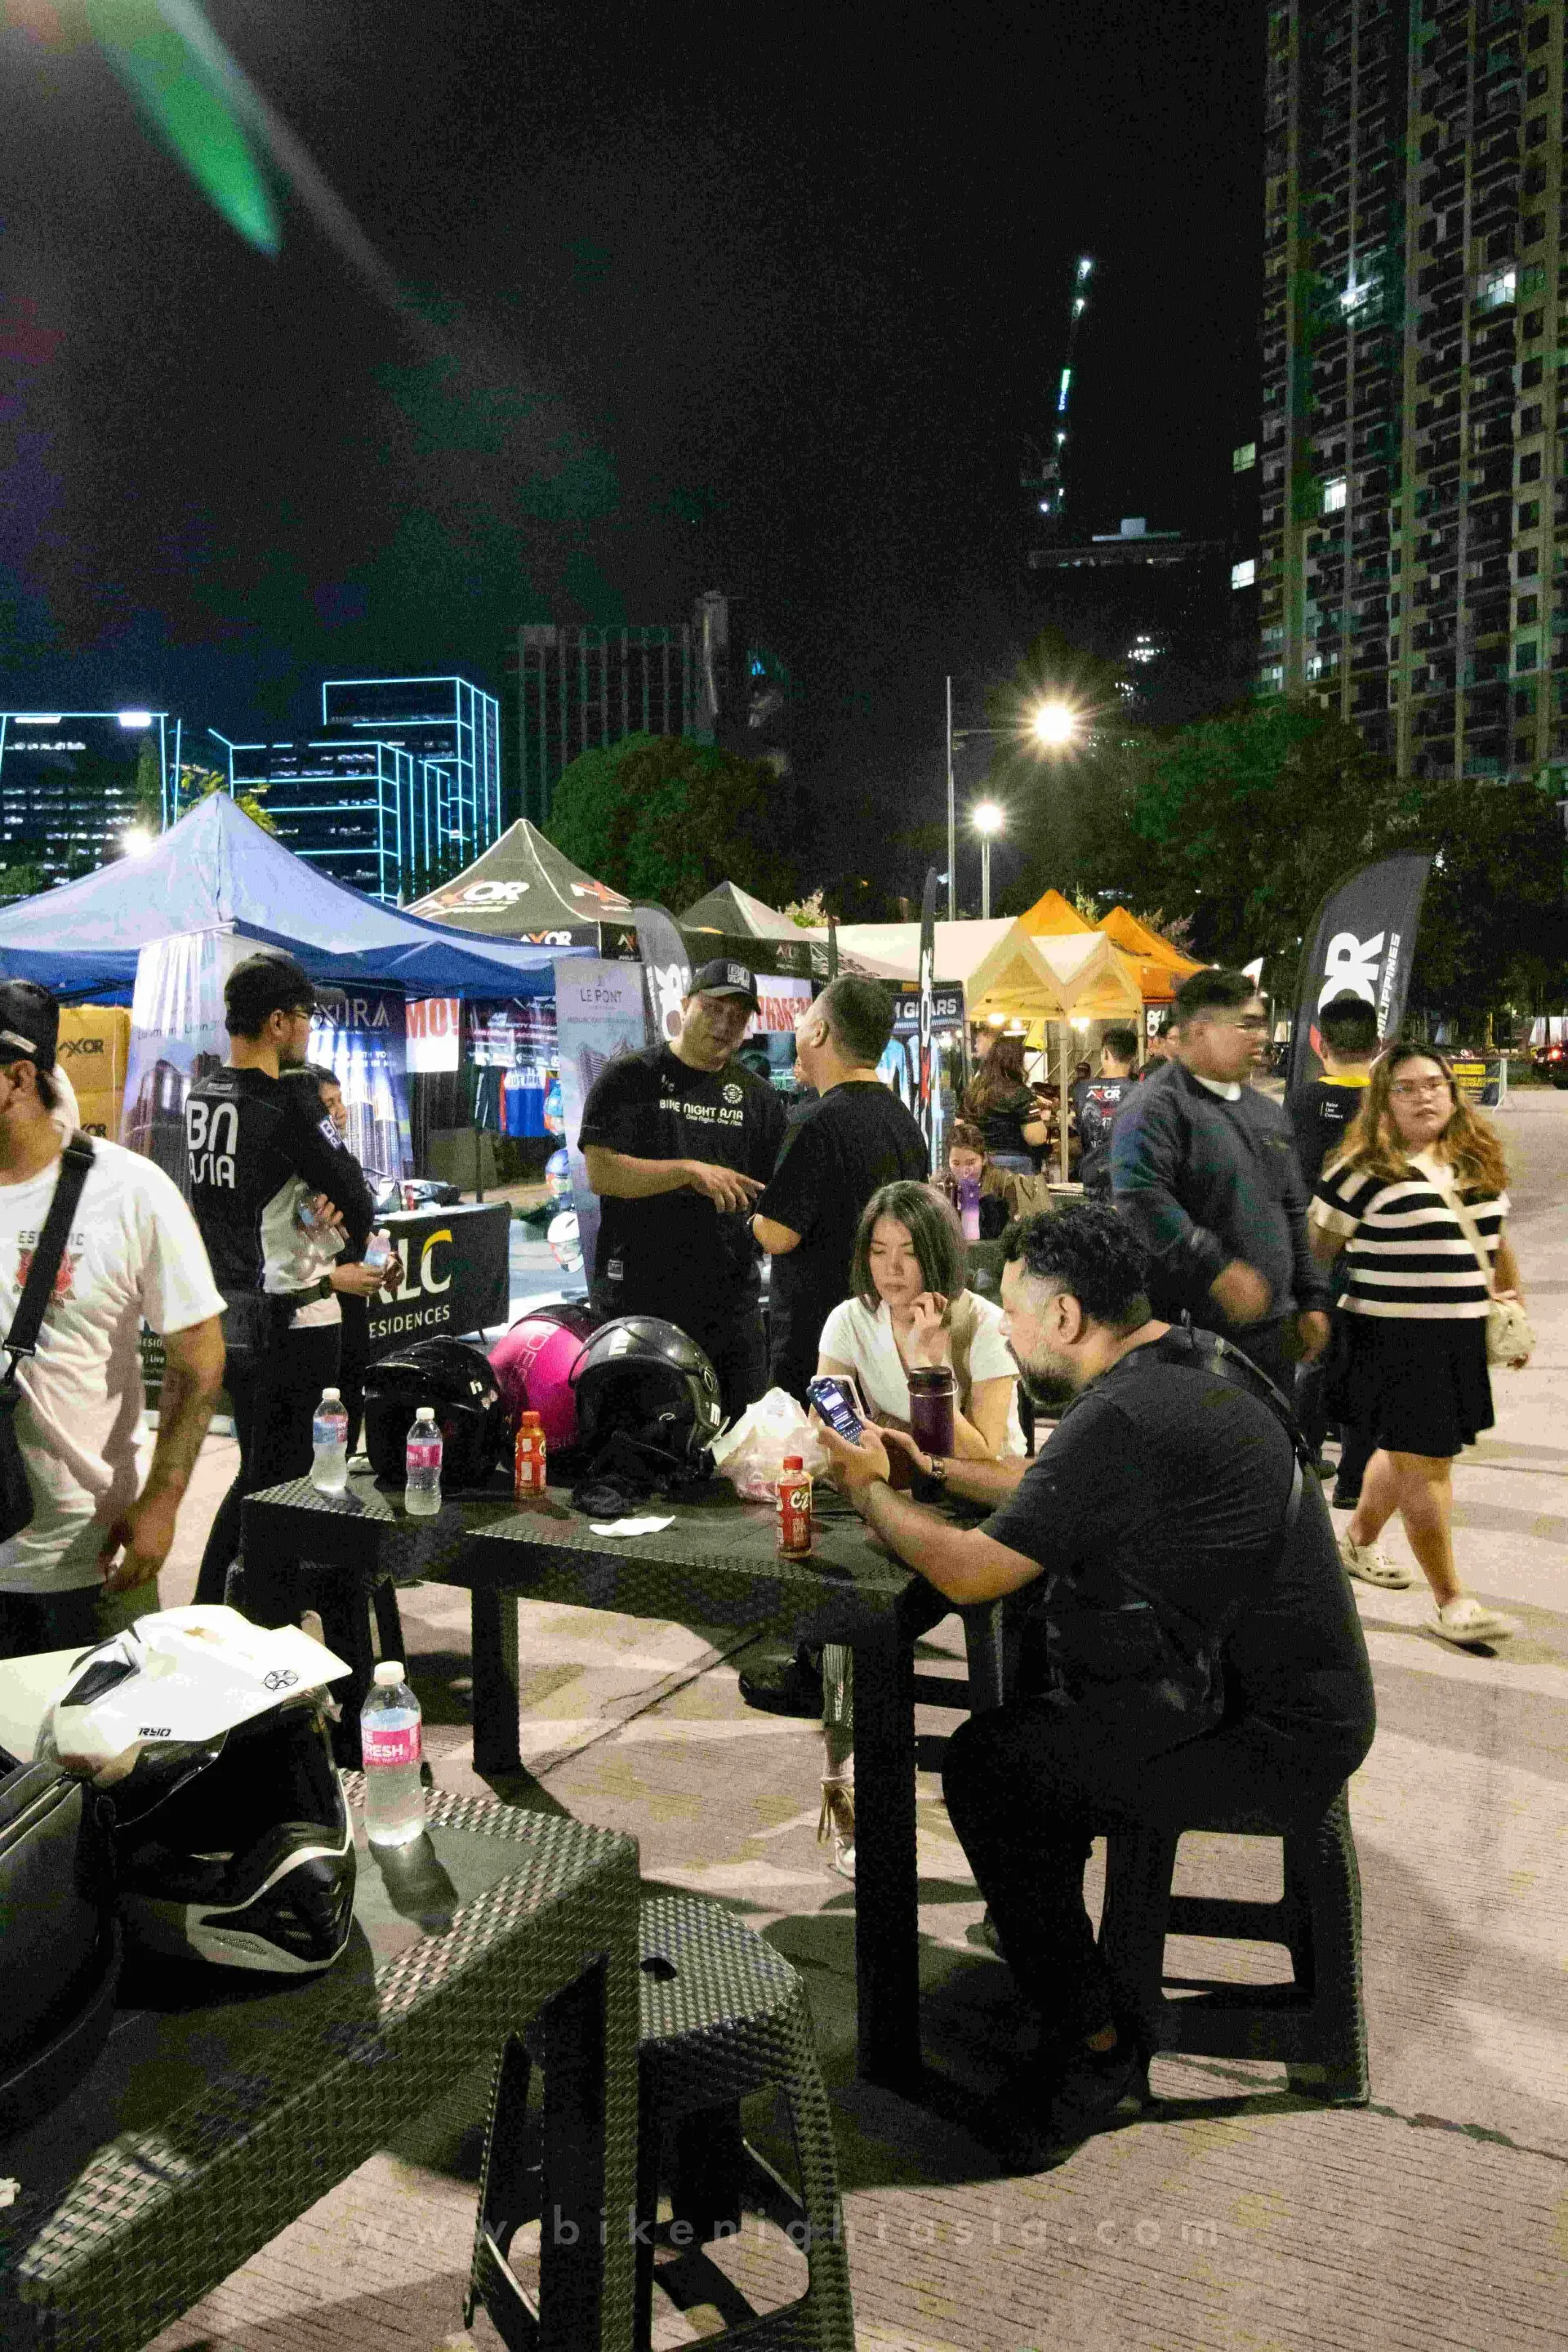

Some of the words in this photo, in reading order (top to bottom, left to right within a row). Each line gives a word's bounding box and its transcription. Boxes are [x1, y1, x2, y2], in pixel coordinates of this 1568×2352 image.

[580, 989, 592, 1002] LE
[595, 989, 622, 1003] PONT
[58, 1037, 105, 1058] AXOR
[659, 1098, 681, 1112] BIKE
[683, 1102, 717, 1117] NIGHT
[719, 1107, 744, 1120] ASIA
[188, 1151, 235, 1189] ASIA
[368, 1304, 451, 1339] ESIDENCES
